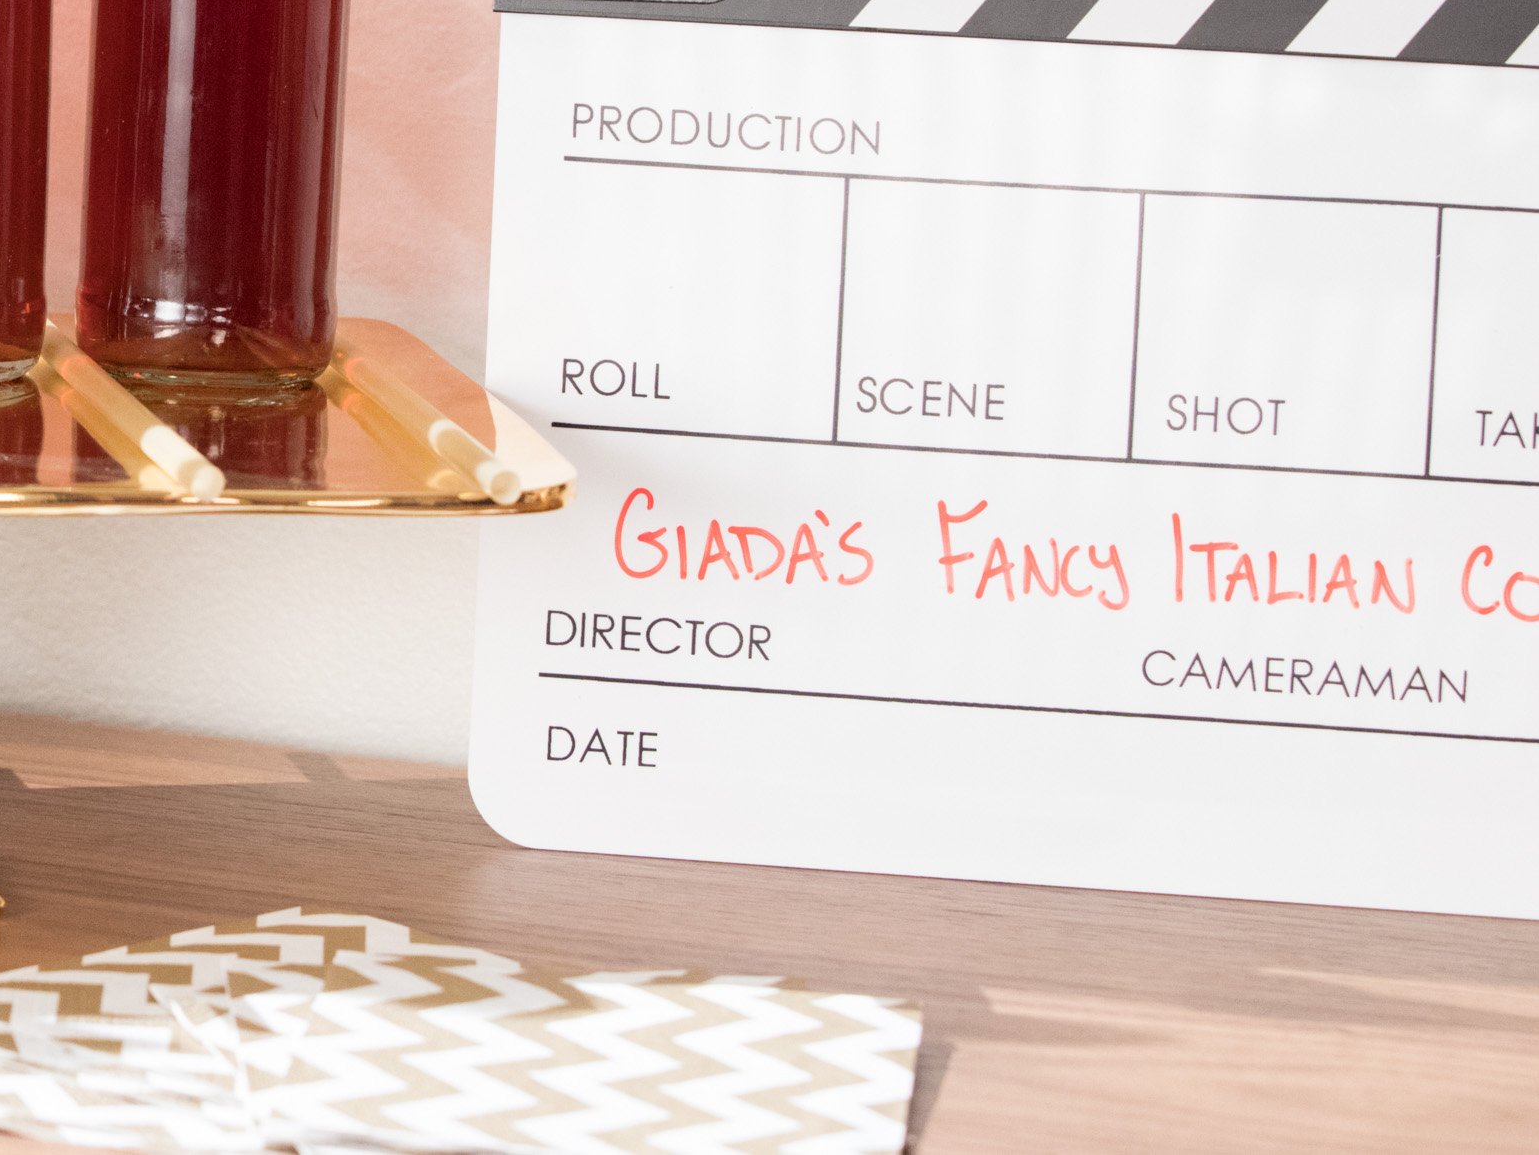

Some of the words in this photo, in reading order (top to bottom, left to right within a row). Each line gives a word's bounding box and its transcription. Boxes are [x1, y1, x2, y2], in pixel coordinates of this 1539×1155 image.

[570, 102, 882, 157] PRODUCTION
[560, 358, 672, 401] ROLL
[856, 375, 1007, 422] SCENE
[1165, 393, 1287, 437] SHOT
[613, 486, 875, 586] GIADA'S
[937, 499, 1131, 611] FANCY
[1171, 512, 1417, 615] ITALIAN
[544, 609, 773, 662] DIRECTOR
[1141, 649, 1470, 705] CAMERAMAN
[545, 725, 660, 769] DATE
